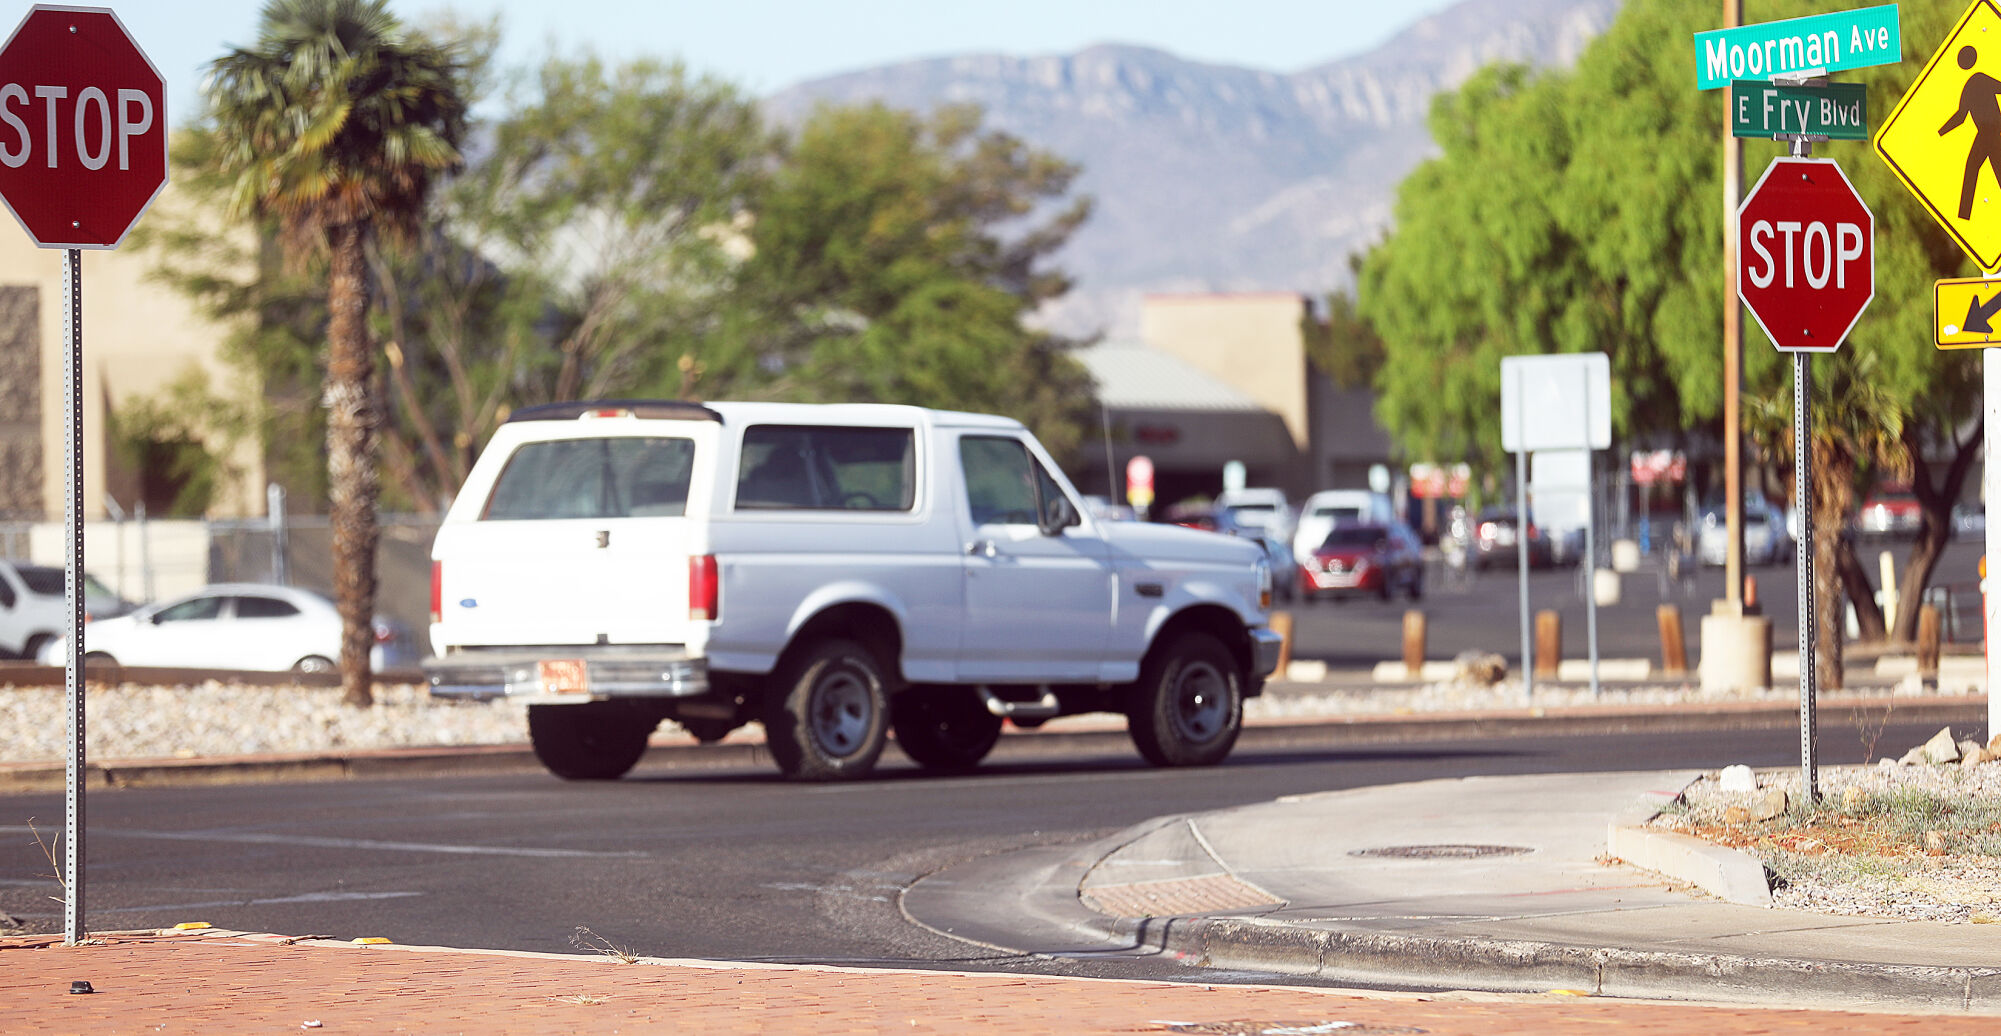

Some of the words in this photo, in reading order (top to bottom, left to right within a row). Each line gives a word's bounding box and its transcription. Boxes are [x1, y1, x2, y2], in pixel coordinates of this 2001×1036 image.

[1705, 30, 1840, 81] Moorman
[1850, 24, 1889, 54] Ave
[0, 82, 154, 171] STOP
[1739, 95, 1750, 124] E
[1763, 89, 1810, 135] Fry
[1820, 97, 1860, 127] Blvd
[1748, 219, 1864, 290] STOP
